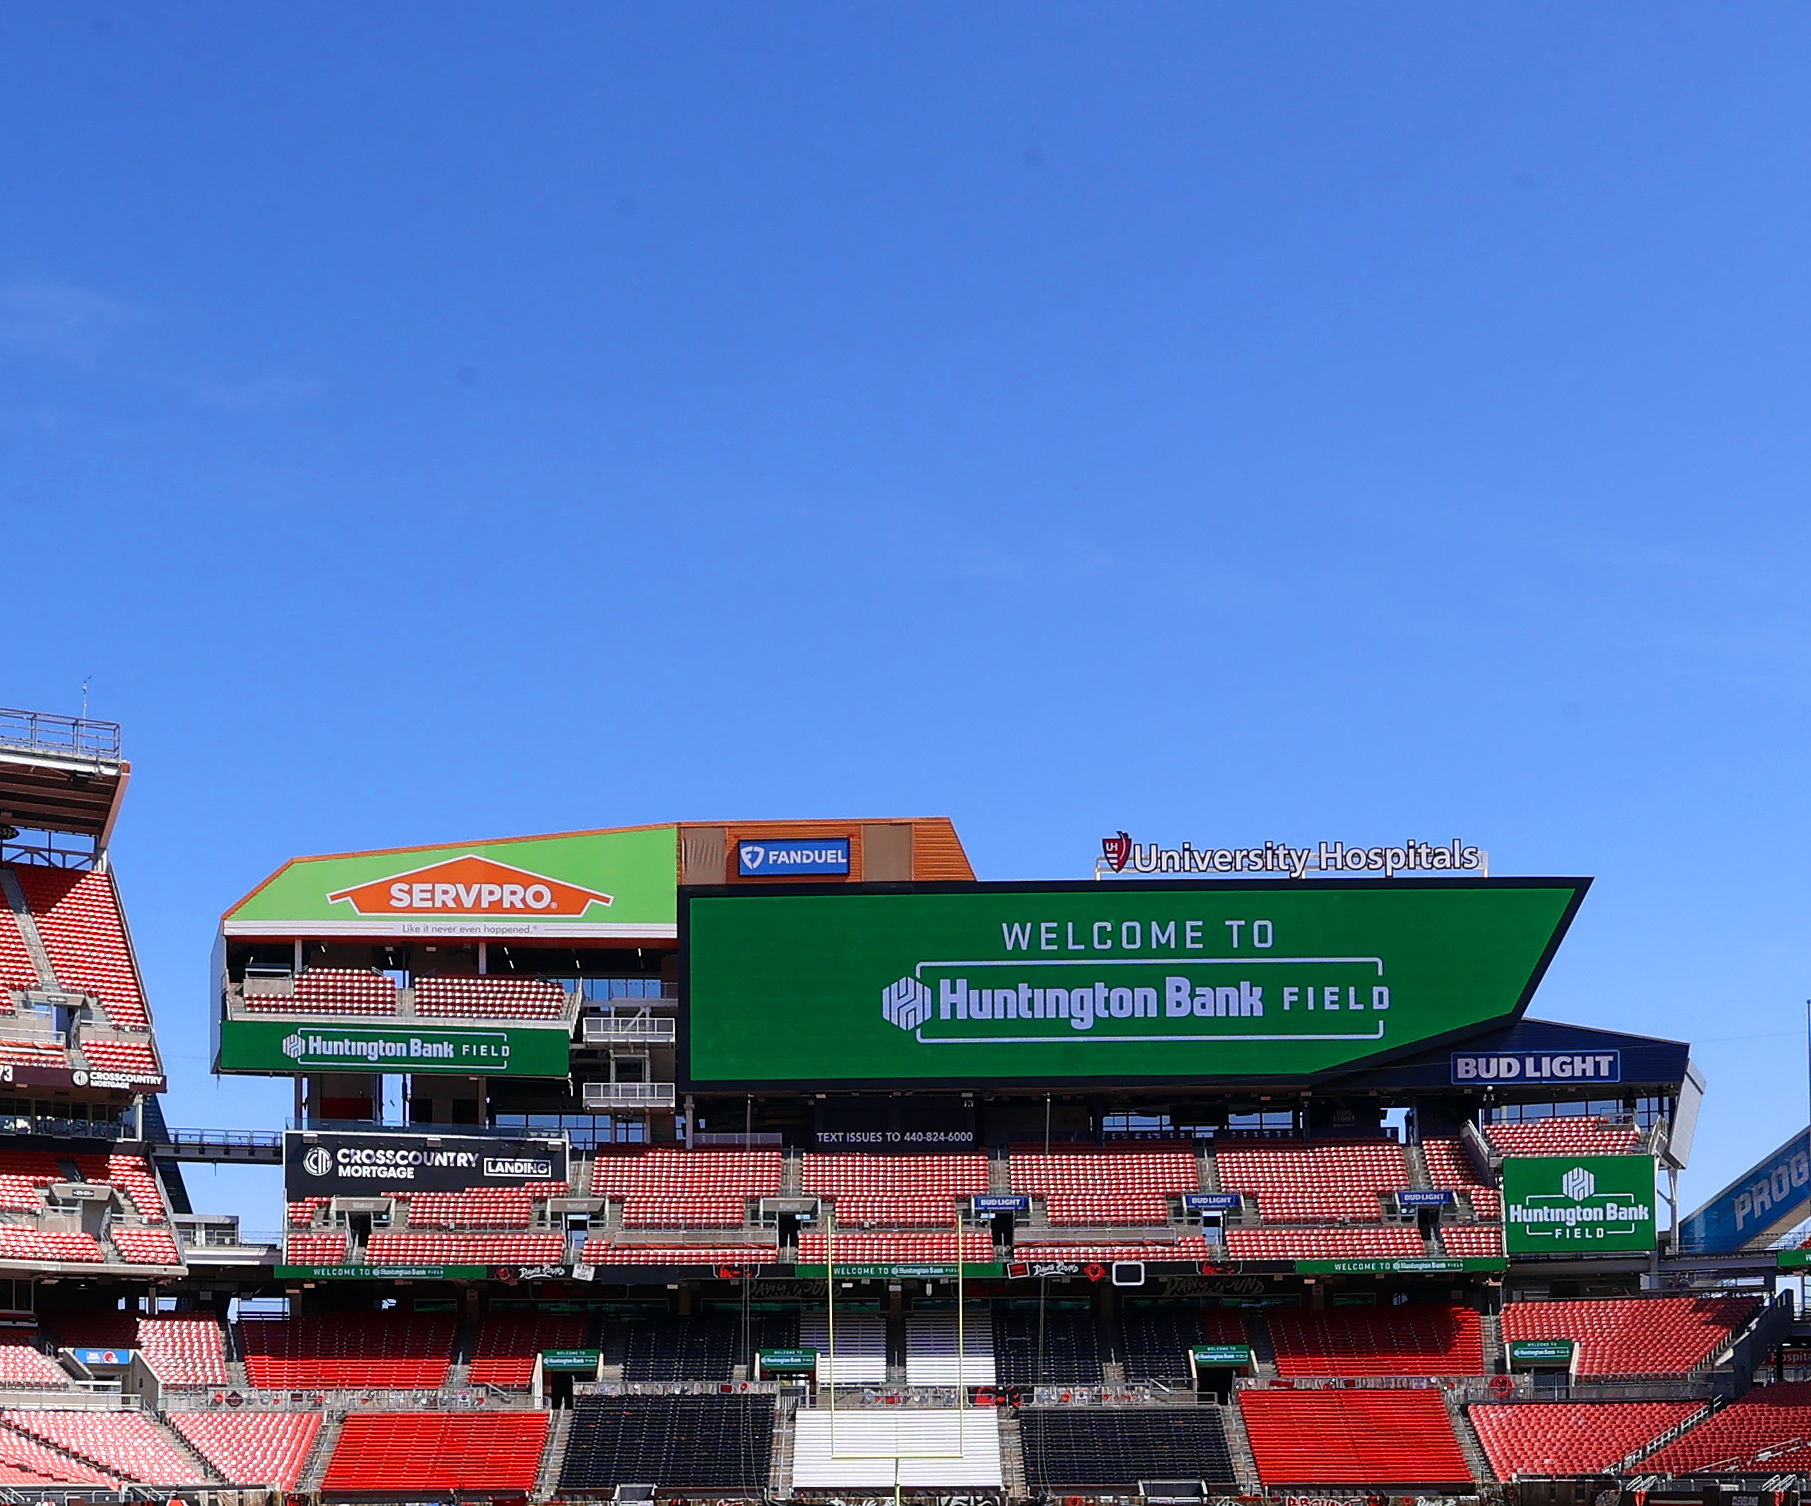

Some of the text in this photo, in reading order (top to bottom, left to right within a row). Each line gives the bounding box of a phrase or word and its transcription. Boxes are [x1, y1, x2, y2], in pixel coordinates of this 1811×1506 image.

[768, 849, 847, 864] FANDUEL
[1133, 839, 1480, 878] University Hospitals
[402, 923, 420, 934] Like
[422, 924, 429, 934] it
[431, 926, 456, 934] never
[459, 926, 480, 934] even
[1002, 919, 1274, 951] WELCOME TO
[939, 976, 1389, 1030] Huntington Bank FIELD
[308, 1036, 511, 1061] Huntington Bank FIELD
[1457, 1054, 1614, 1082] BUD LIGHT
[89, 1071, 163, 1086] CROSSCOUNTRY
[817, 1131, 974, 1143] TEXT ISSUES TO 440-824-6000
[337, 1149, 479, 1168] CROSSCOUNTRY
[338, 1166, 415, 1179] MORTGAGE
[487, 1161, 548, 1174] LANDING
[980, 1198, 1021, 1206] BUD LIGHT
[1191, 1196, 1232, 1205] BUD LIGHT
[1404, 1192, 1445, 1201] BUD LIGHT
[1510, 1203, 1649, 1226] Huntington Bank
[1555, 1228, 1604, 1239] FIELD
[314, 1268, 370, 1276] WELCOME TO
[834, 1267, 889, 1275] WELCOME TO
[1334, 1262, 1390, 1270] WELCOME TO
